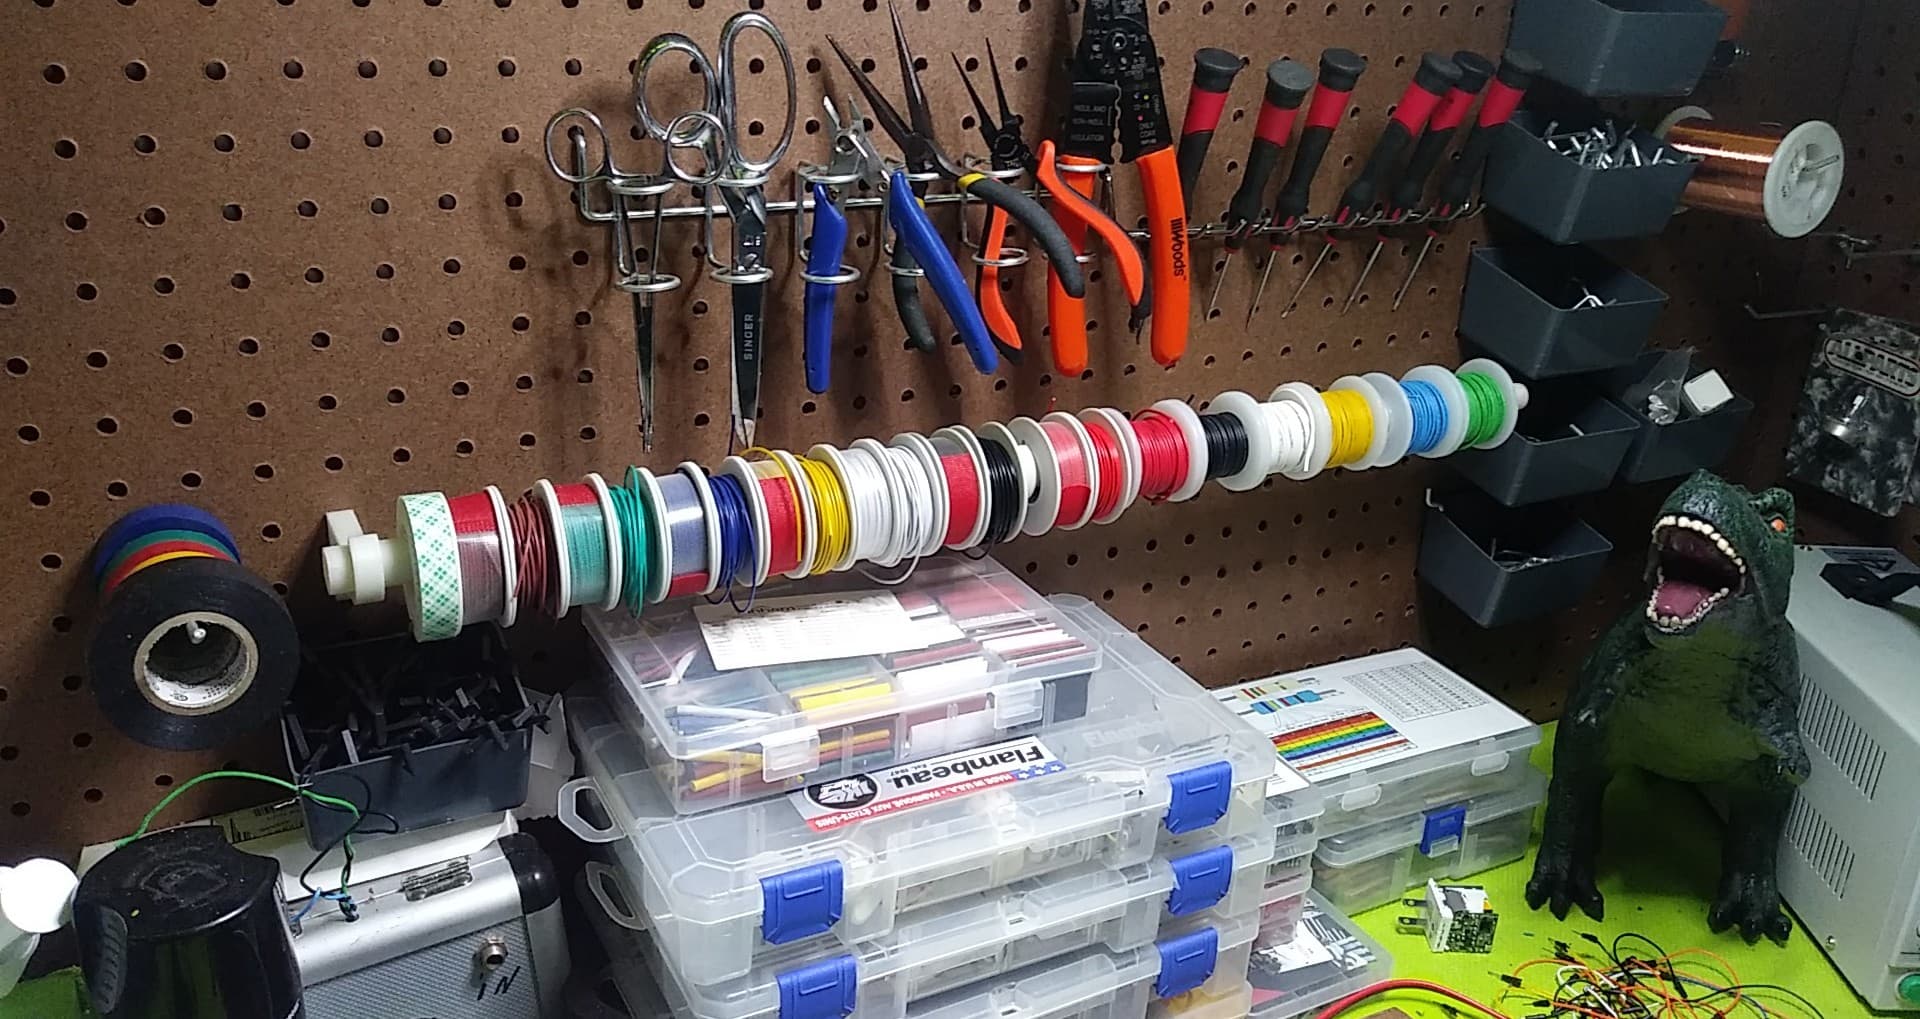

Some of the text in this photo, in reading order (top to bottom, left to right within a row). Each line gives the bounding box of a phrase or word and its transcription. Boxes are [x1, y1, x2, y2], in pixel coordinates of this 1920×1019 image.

[743, 313, 754, 361] SINGER
[893, 745, 1045, 789] Flambeau
[477, 965, 521, 1000] IN
